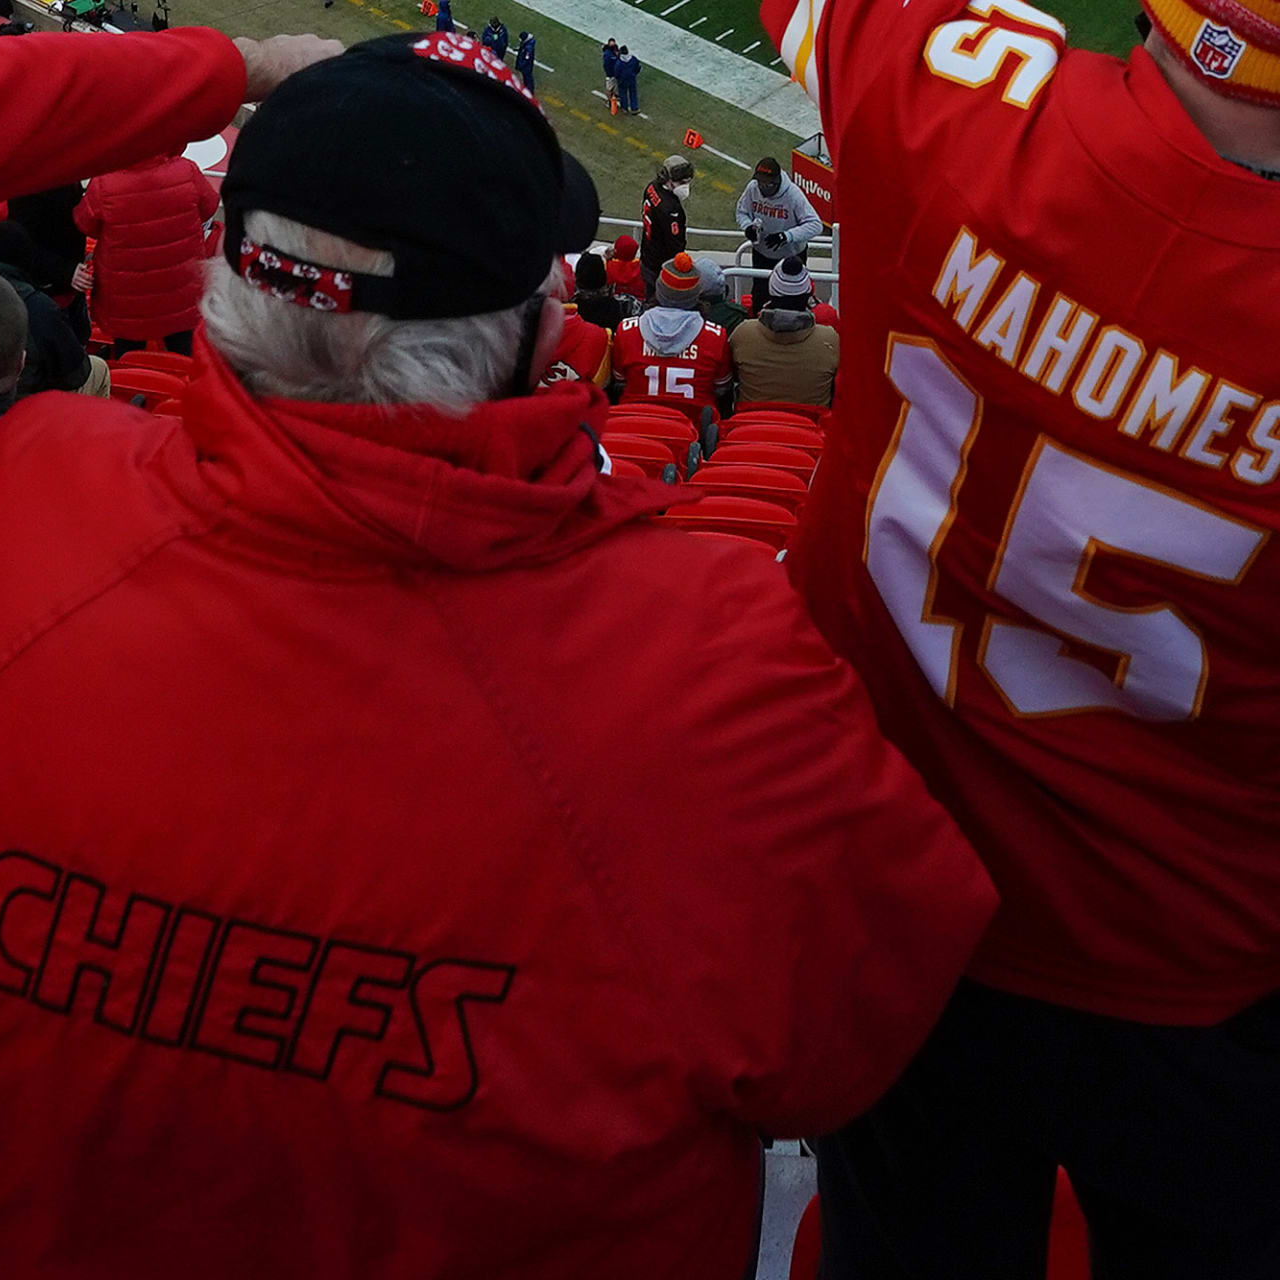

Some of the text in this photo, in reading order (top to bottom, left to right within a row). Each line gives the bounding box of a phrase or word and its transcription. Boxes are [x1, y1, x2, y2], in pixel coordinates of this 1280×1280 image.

[793, 172, 832, 203] HyVee
[751, 202, 790, 221] BROWNS
[644, 365, 696, 402] 15
[863, 330, 1271, 723] 15
